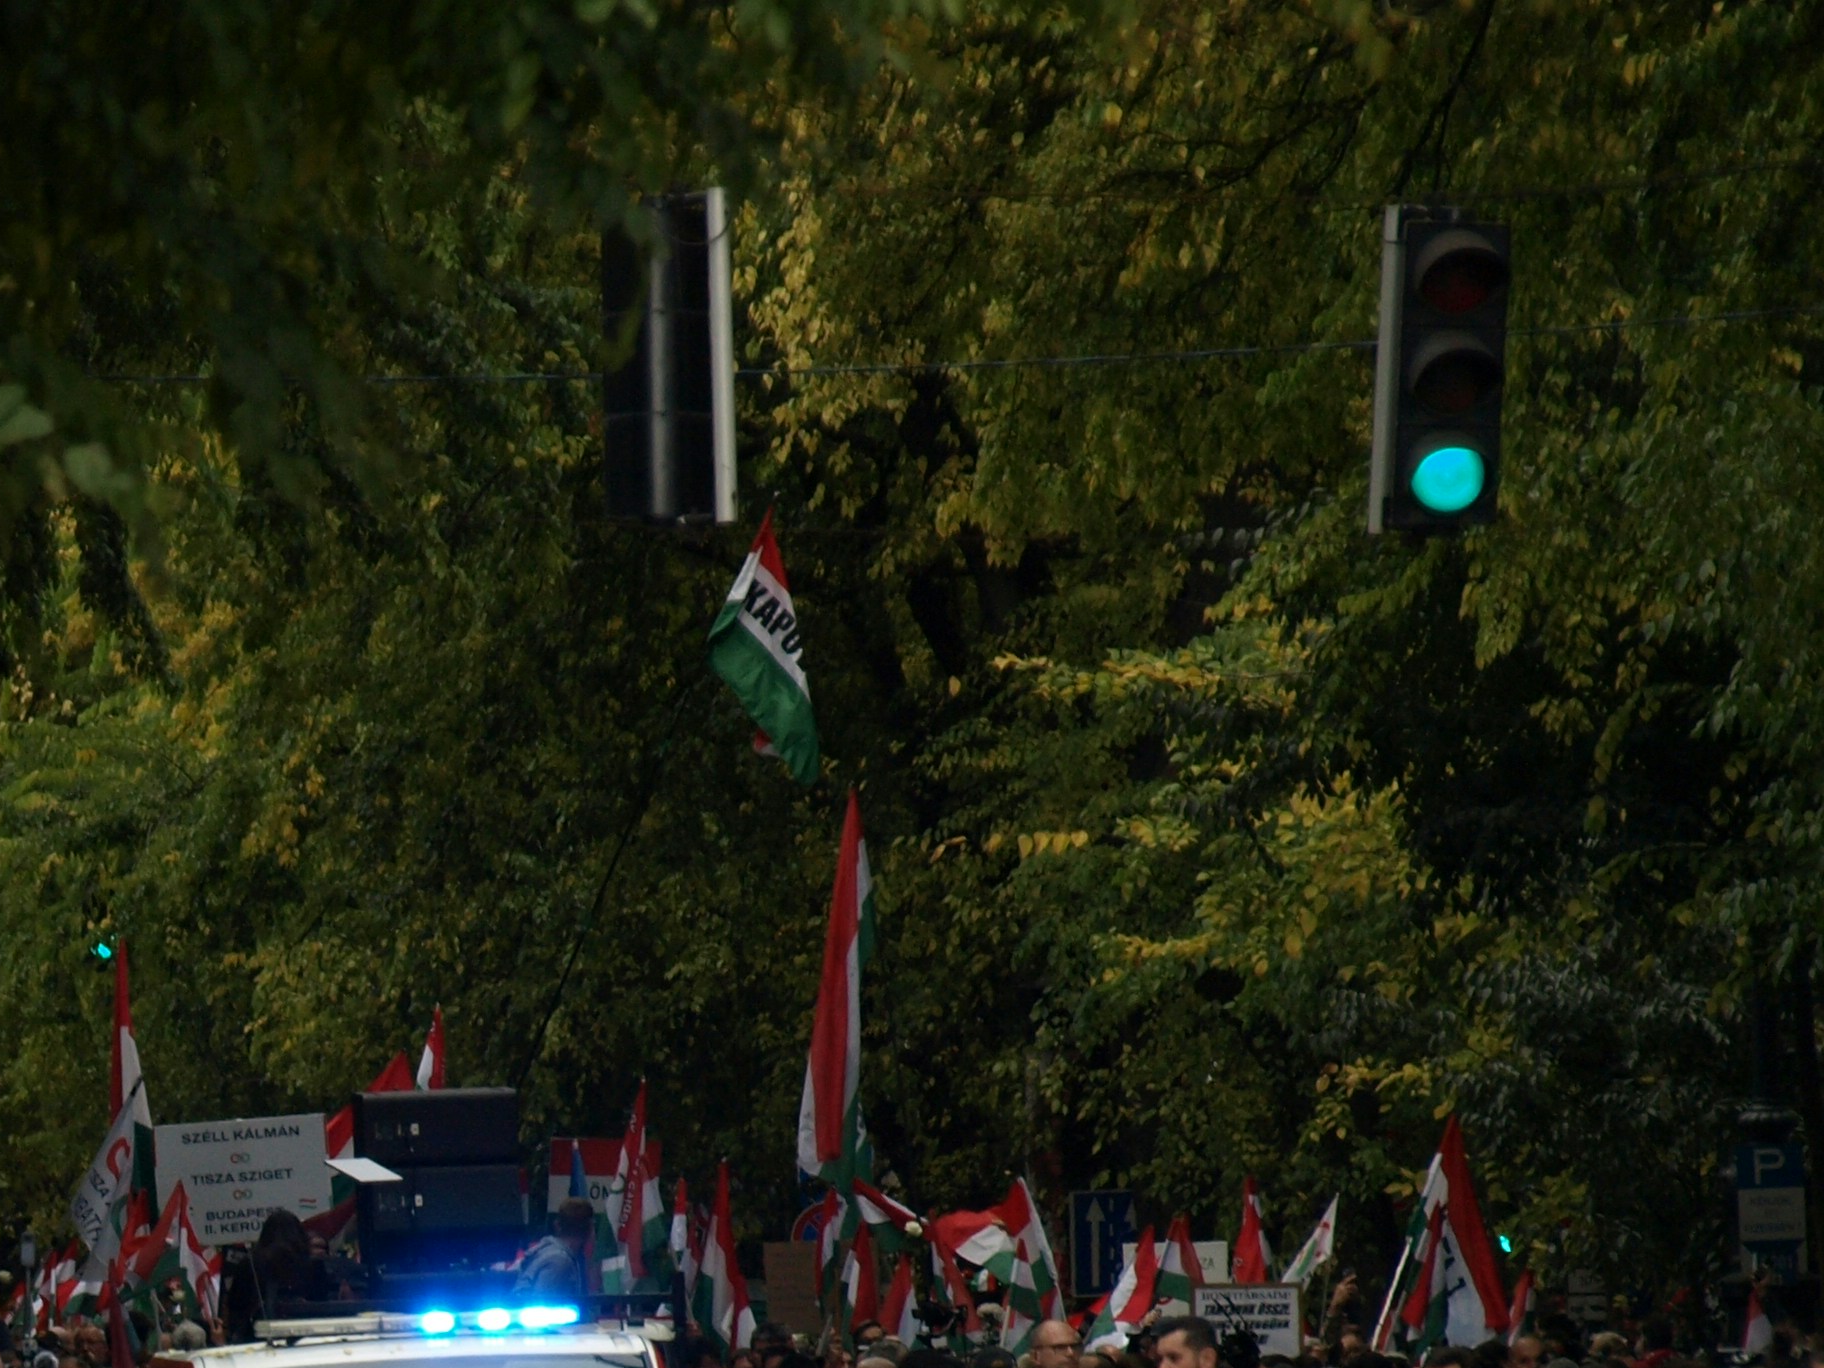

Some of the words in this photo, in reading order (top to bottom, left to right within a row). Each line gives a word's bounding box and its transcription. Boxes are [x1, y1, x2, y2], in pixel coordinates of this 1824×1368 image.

[182, 1129, 231, 1145] SZÉLL
[233, 1125, 300, 1142] KÁLMÁN
[1753, 1147, 1786, 1185] P
[192, 1172, 236, 1186] TISZA
[239, 1168, 293, 1182] SZIGET
